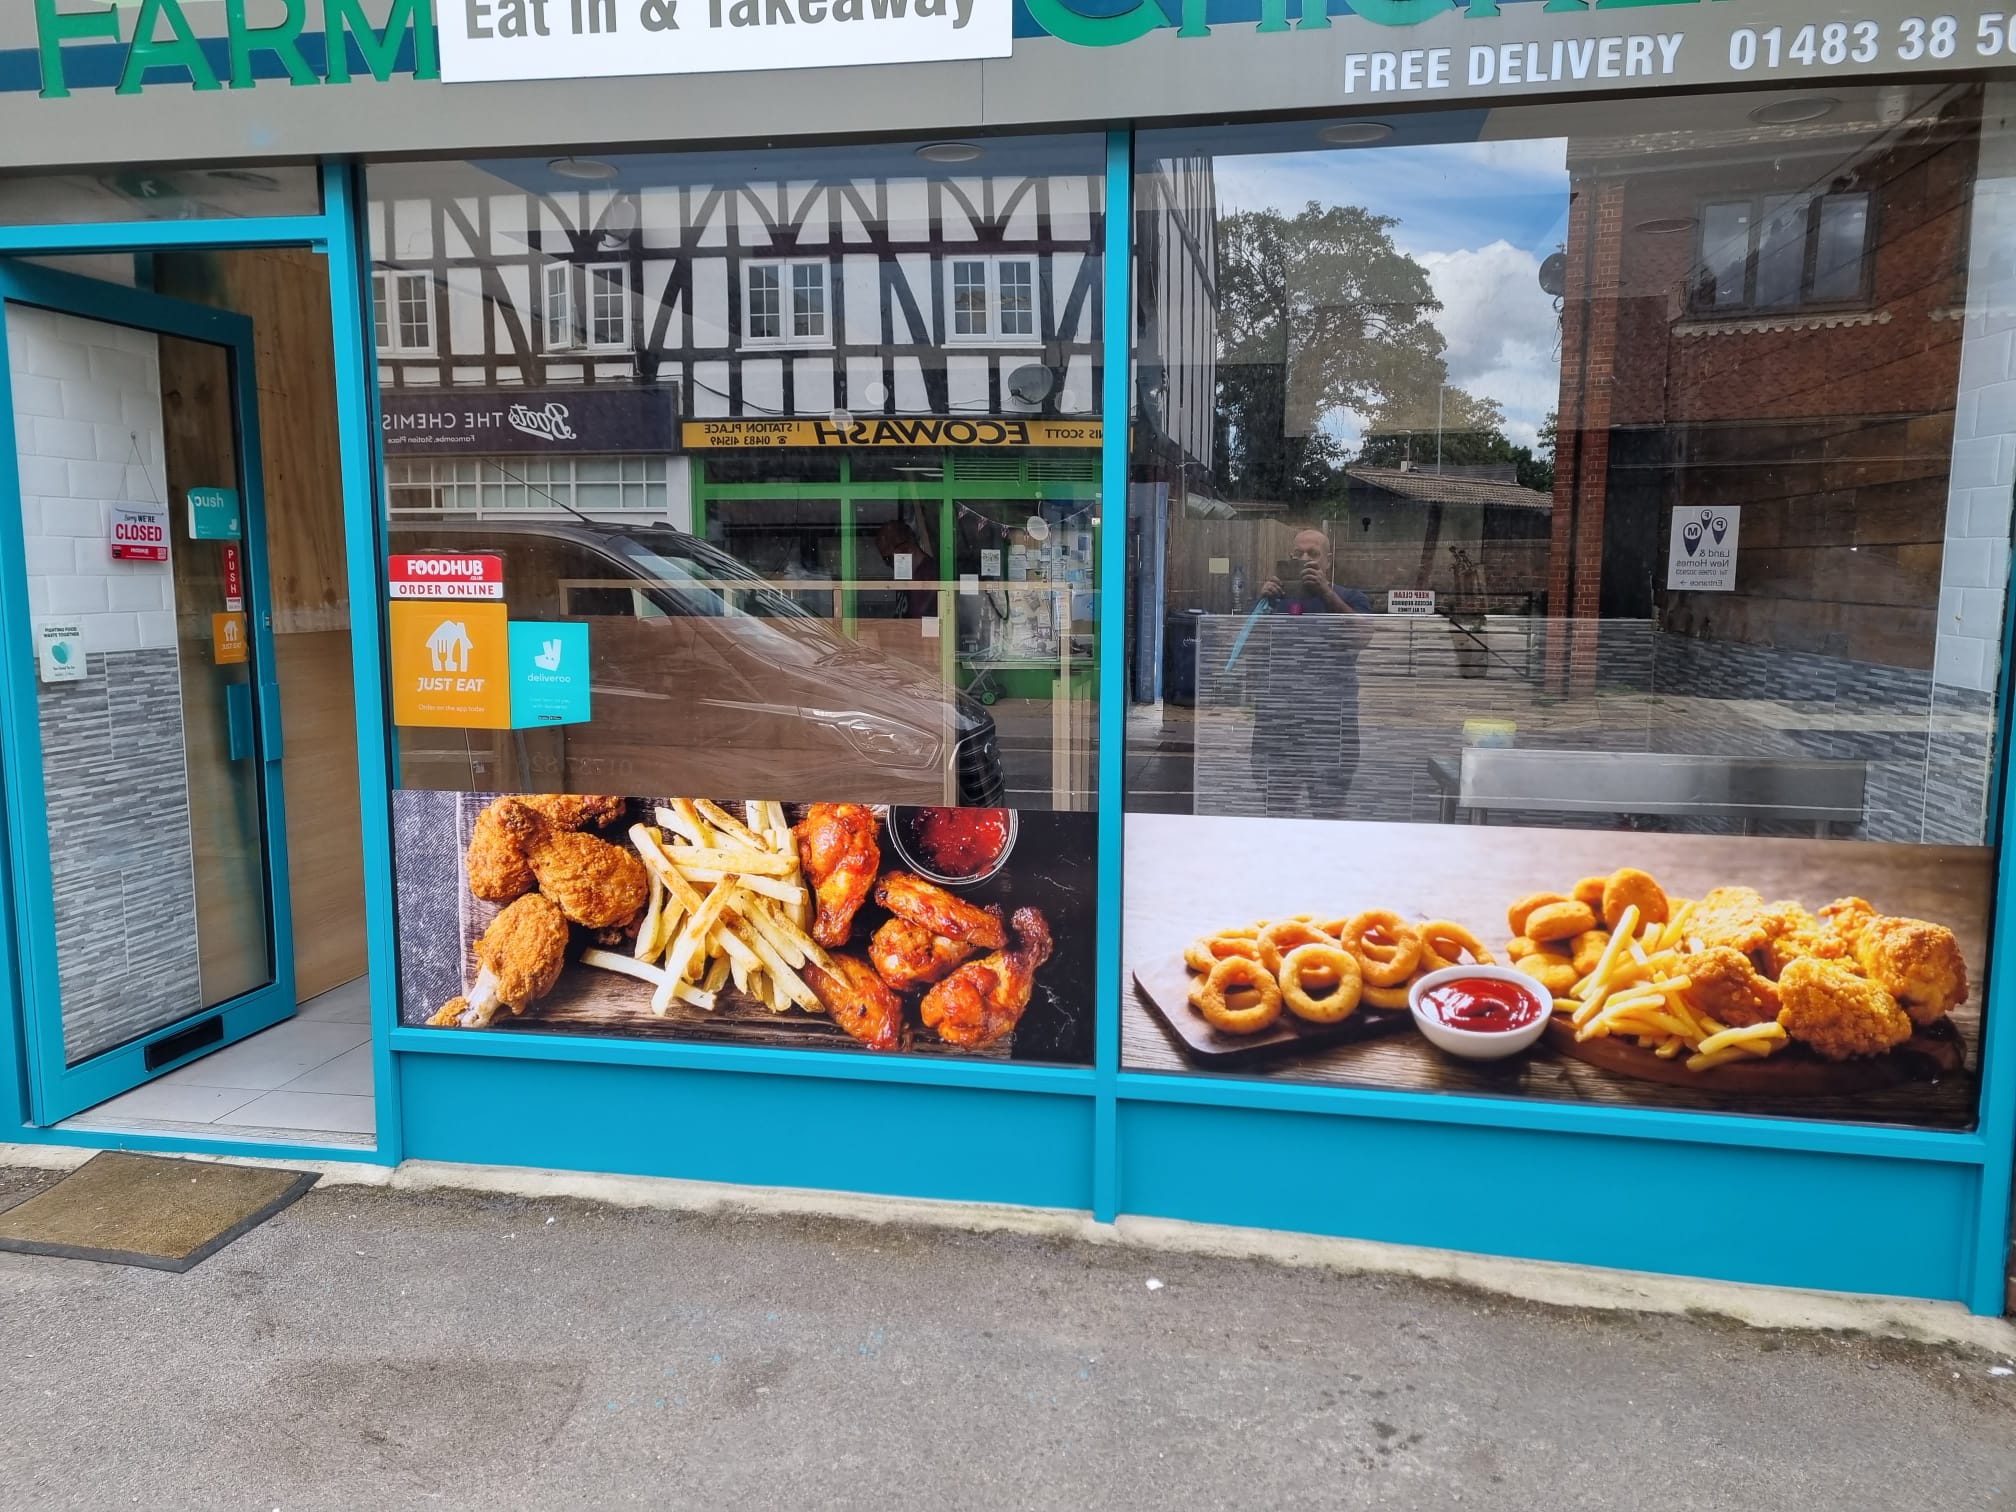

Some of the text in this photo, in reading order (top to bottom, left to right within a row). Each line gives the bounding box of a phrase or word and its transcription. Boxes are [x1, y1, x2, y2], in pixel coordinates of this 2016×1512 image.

[465, 0, 550, 39] Eat
[640, 0, 680, 32] &
[34, 0, 439, 99] FARM
[1729, 20, 1879, 71] 01483
[1897, 15, 1958, 61] 38
[1344, 31, 1684, 94] FREE DELIVERY
[116, 523, 162, 541] CLOSED
[228, 549, 237, 594] PUSH
[407, 559, 484, 575] FOODHUB
[399, 584, 495, 595] ORDER ONLINE
[417, 677, 485, 693] JUST EAT
[527, 671, 572, 683] deliveroo
